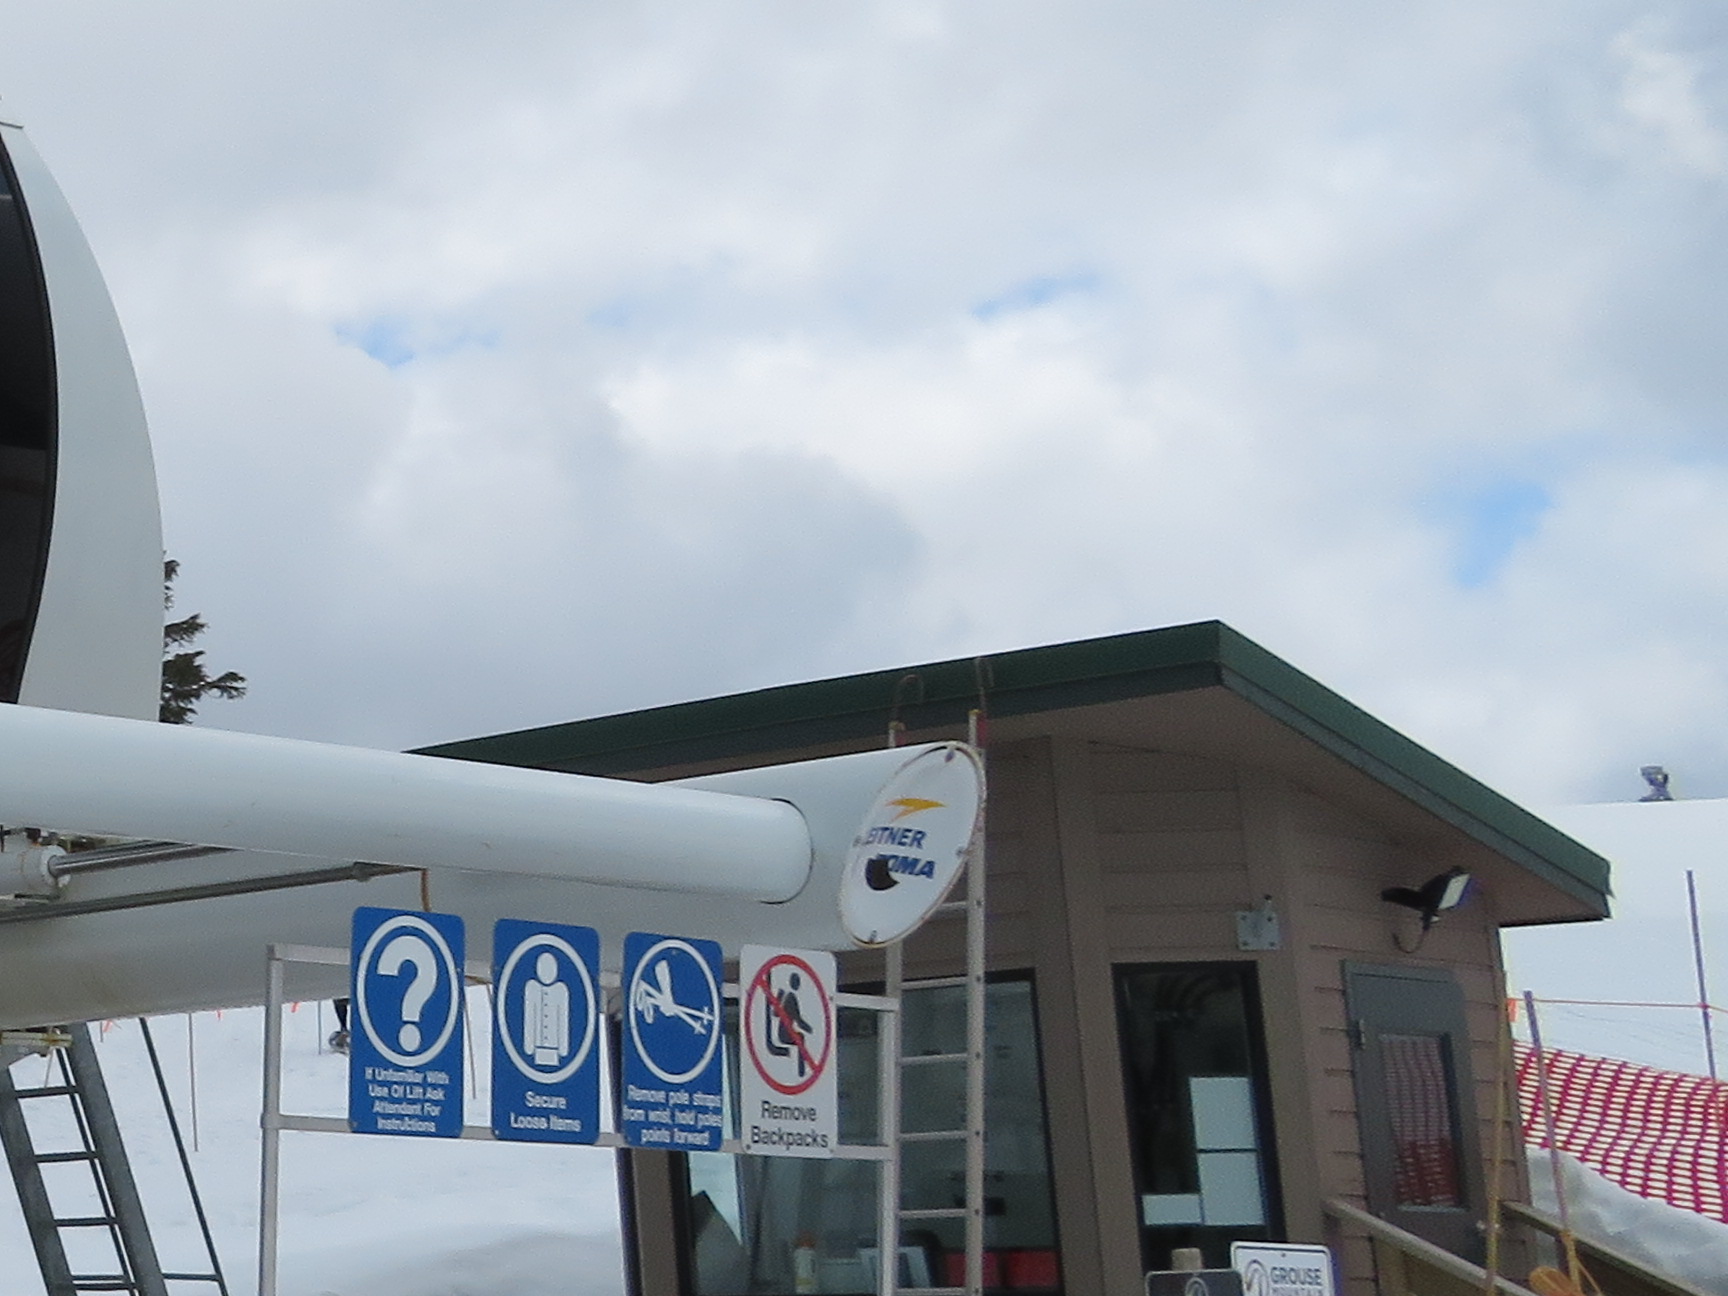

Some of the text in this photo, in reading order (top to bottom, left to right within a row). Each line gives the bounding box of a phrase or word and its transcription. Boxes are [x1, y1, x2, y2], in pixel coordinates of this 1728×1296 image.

[375, 1066, 424, 1083] Unfamiliar
[426, 1070, 450, 1085] With
[368, 1083, 445, 1101] Use Of Lift Ask
[525, 1090, 567, 1110] Secure
[627, 1084, 722, 1110] Remove pole straps
[373, 1099, 442, 1117] Attendant For
[761, 1100, 817, 1122] Remove
[377, 1116, 436, 1132] Instructions
[510, 1112, 582, 1133] Loose Items
[674, 1108, 696, 1125] hold
[697, 1111, 722, 1129] poles
[640, 1126, 711, 1146] points forward
[751, 1125, 829, 1151] Backpacks
[1270, 1266, 1322, 1286] GROUSE
